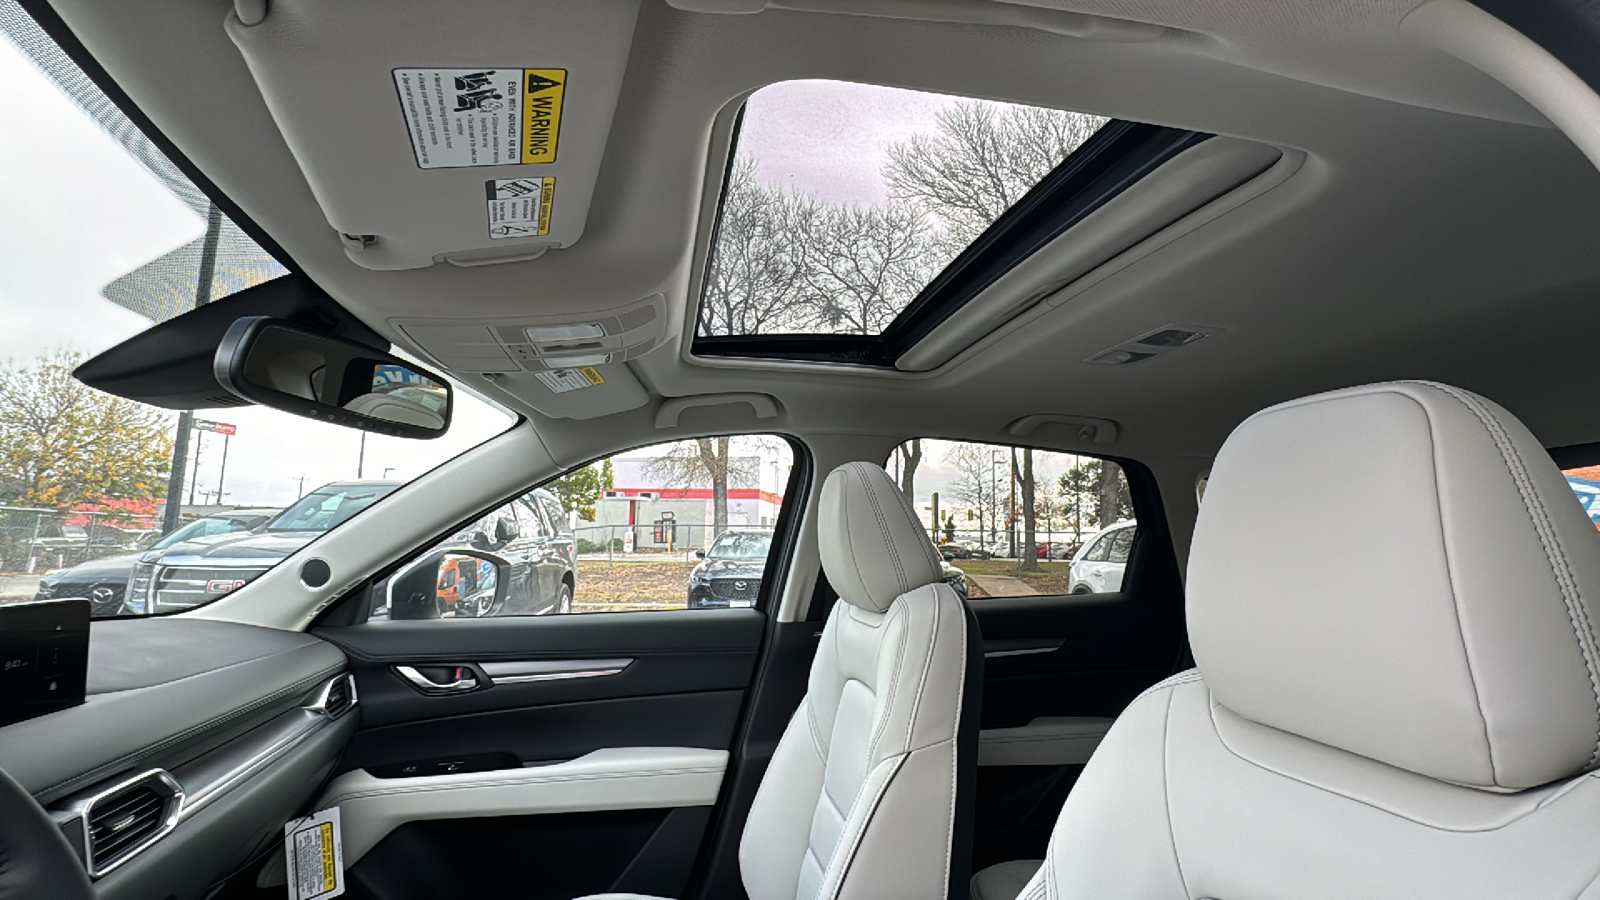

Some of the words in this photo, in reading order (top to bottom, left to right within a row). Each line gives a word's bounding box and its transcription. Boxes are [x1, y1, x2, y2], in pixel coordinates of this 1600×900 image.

[508, 82, 516, 95] EVEN
[508, 98, 516, 111] WITH
[529, 97, 554, 156] WARNING
